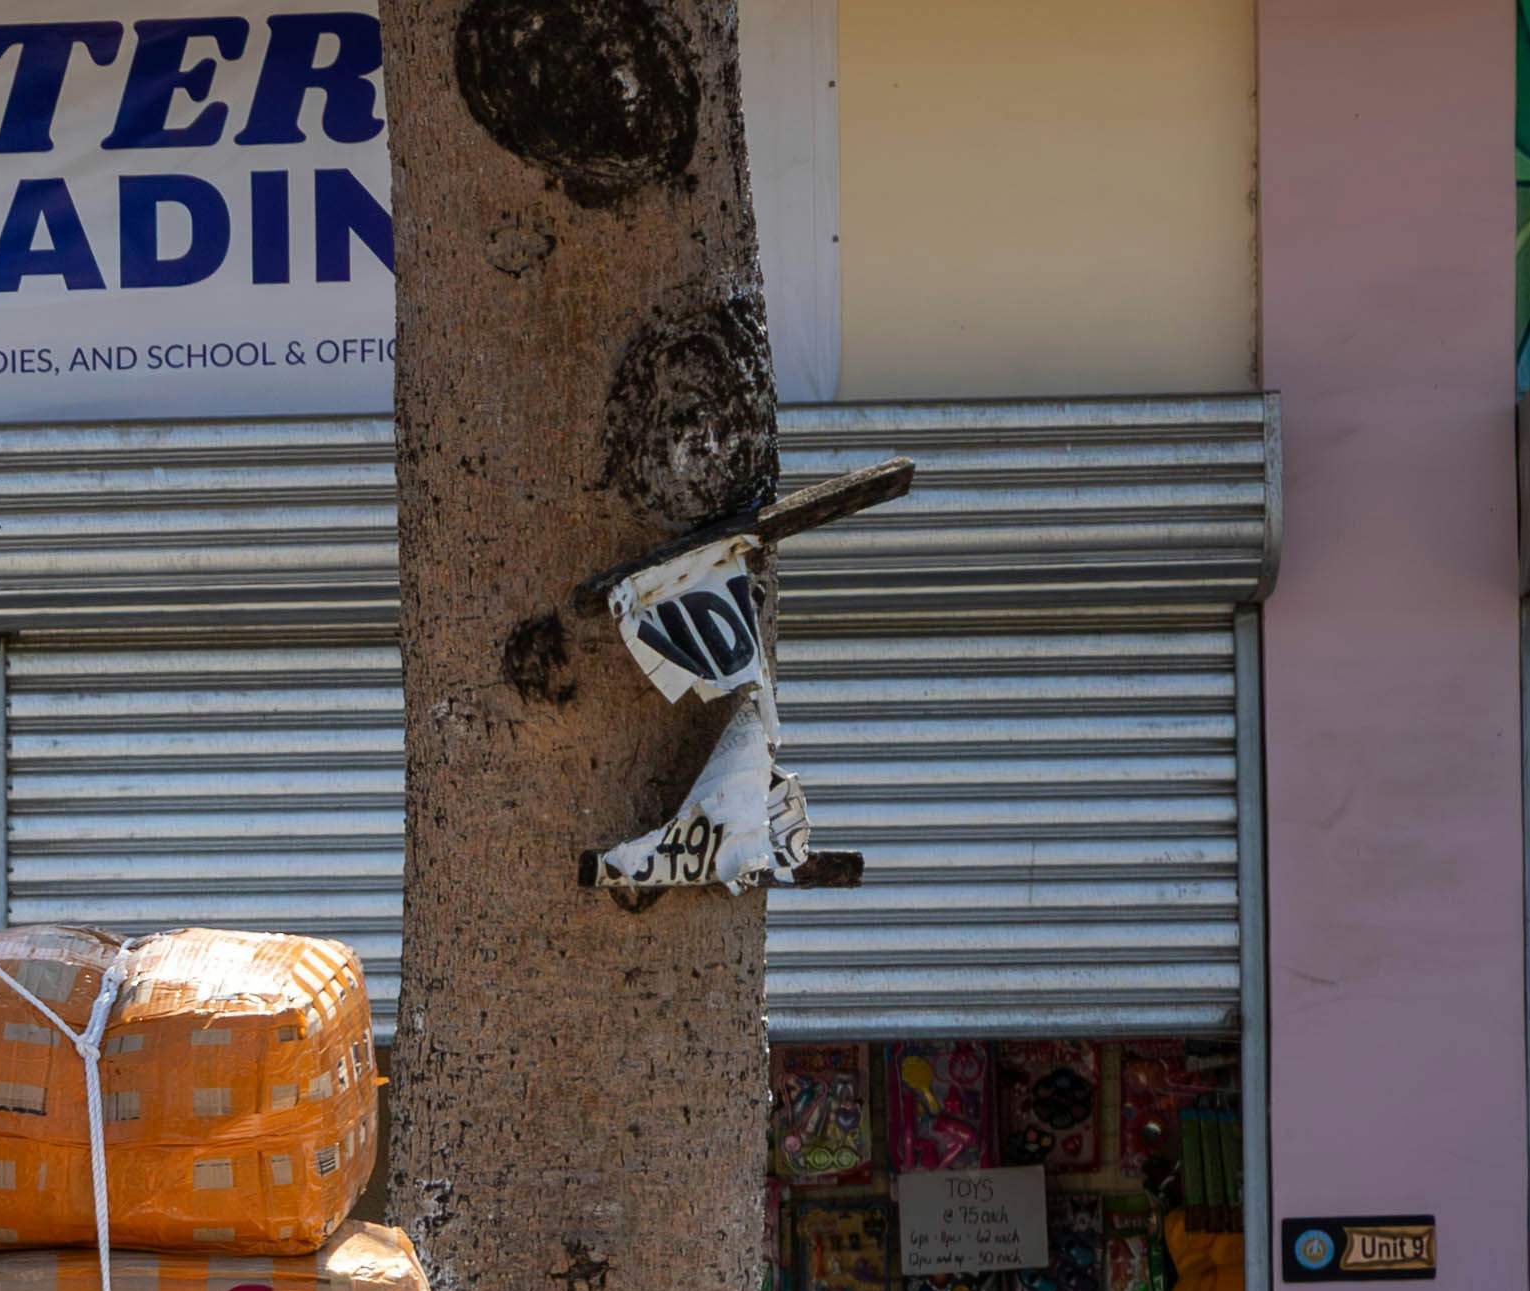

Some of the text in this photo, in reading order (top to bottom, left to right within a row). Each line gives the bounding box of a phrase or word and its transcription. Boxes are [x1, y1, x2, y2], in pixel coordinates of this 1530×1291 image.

[68, 346, 138, 372] AND
[147, 341, 277, 370] SCHOOL
[285, 340, 306, 366] &
[945, 1177, 994, 1202] TOYS
[1361, 1236, 1424, 1259] Unit 9
